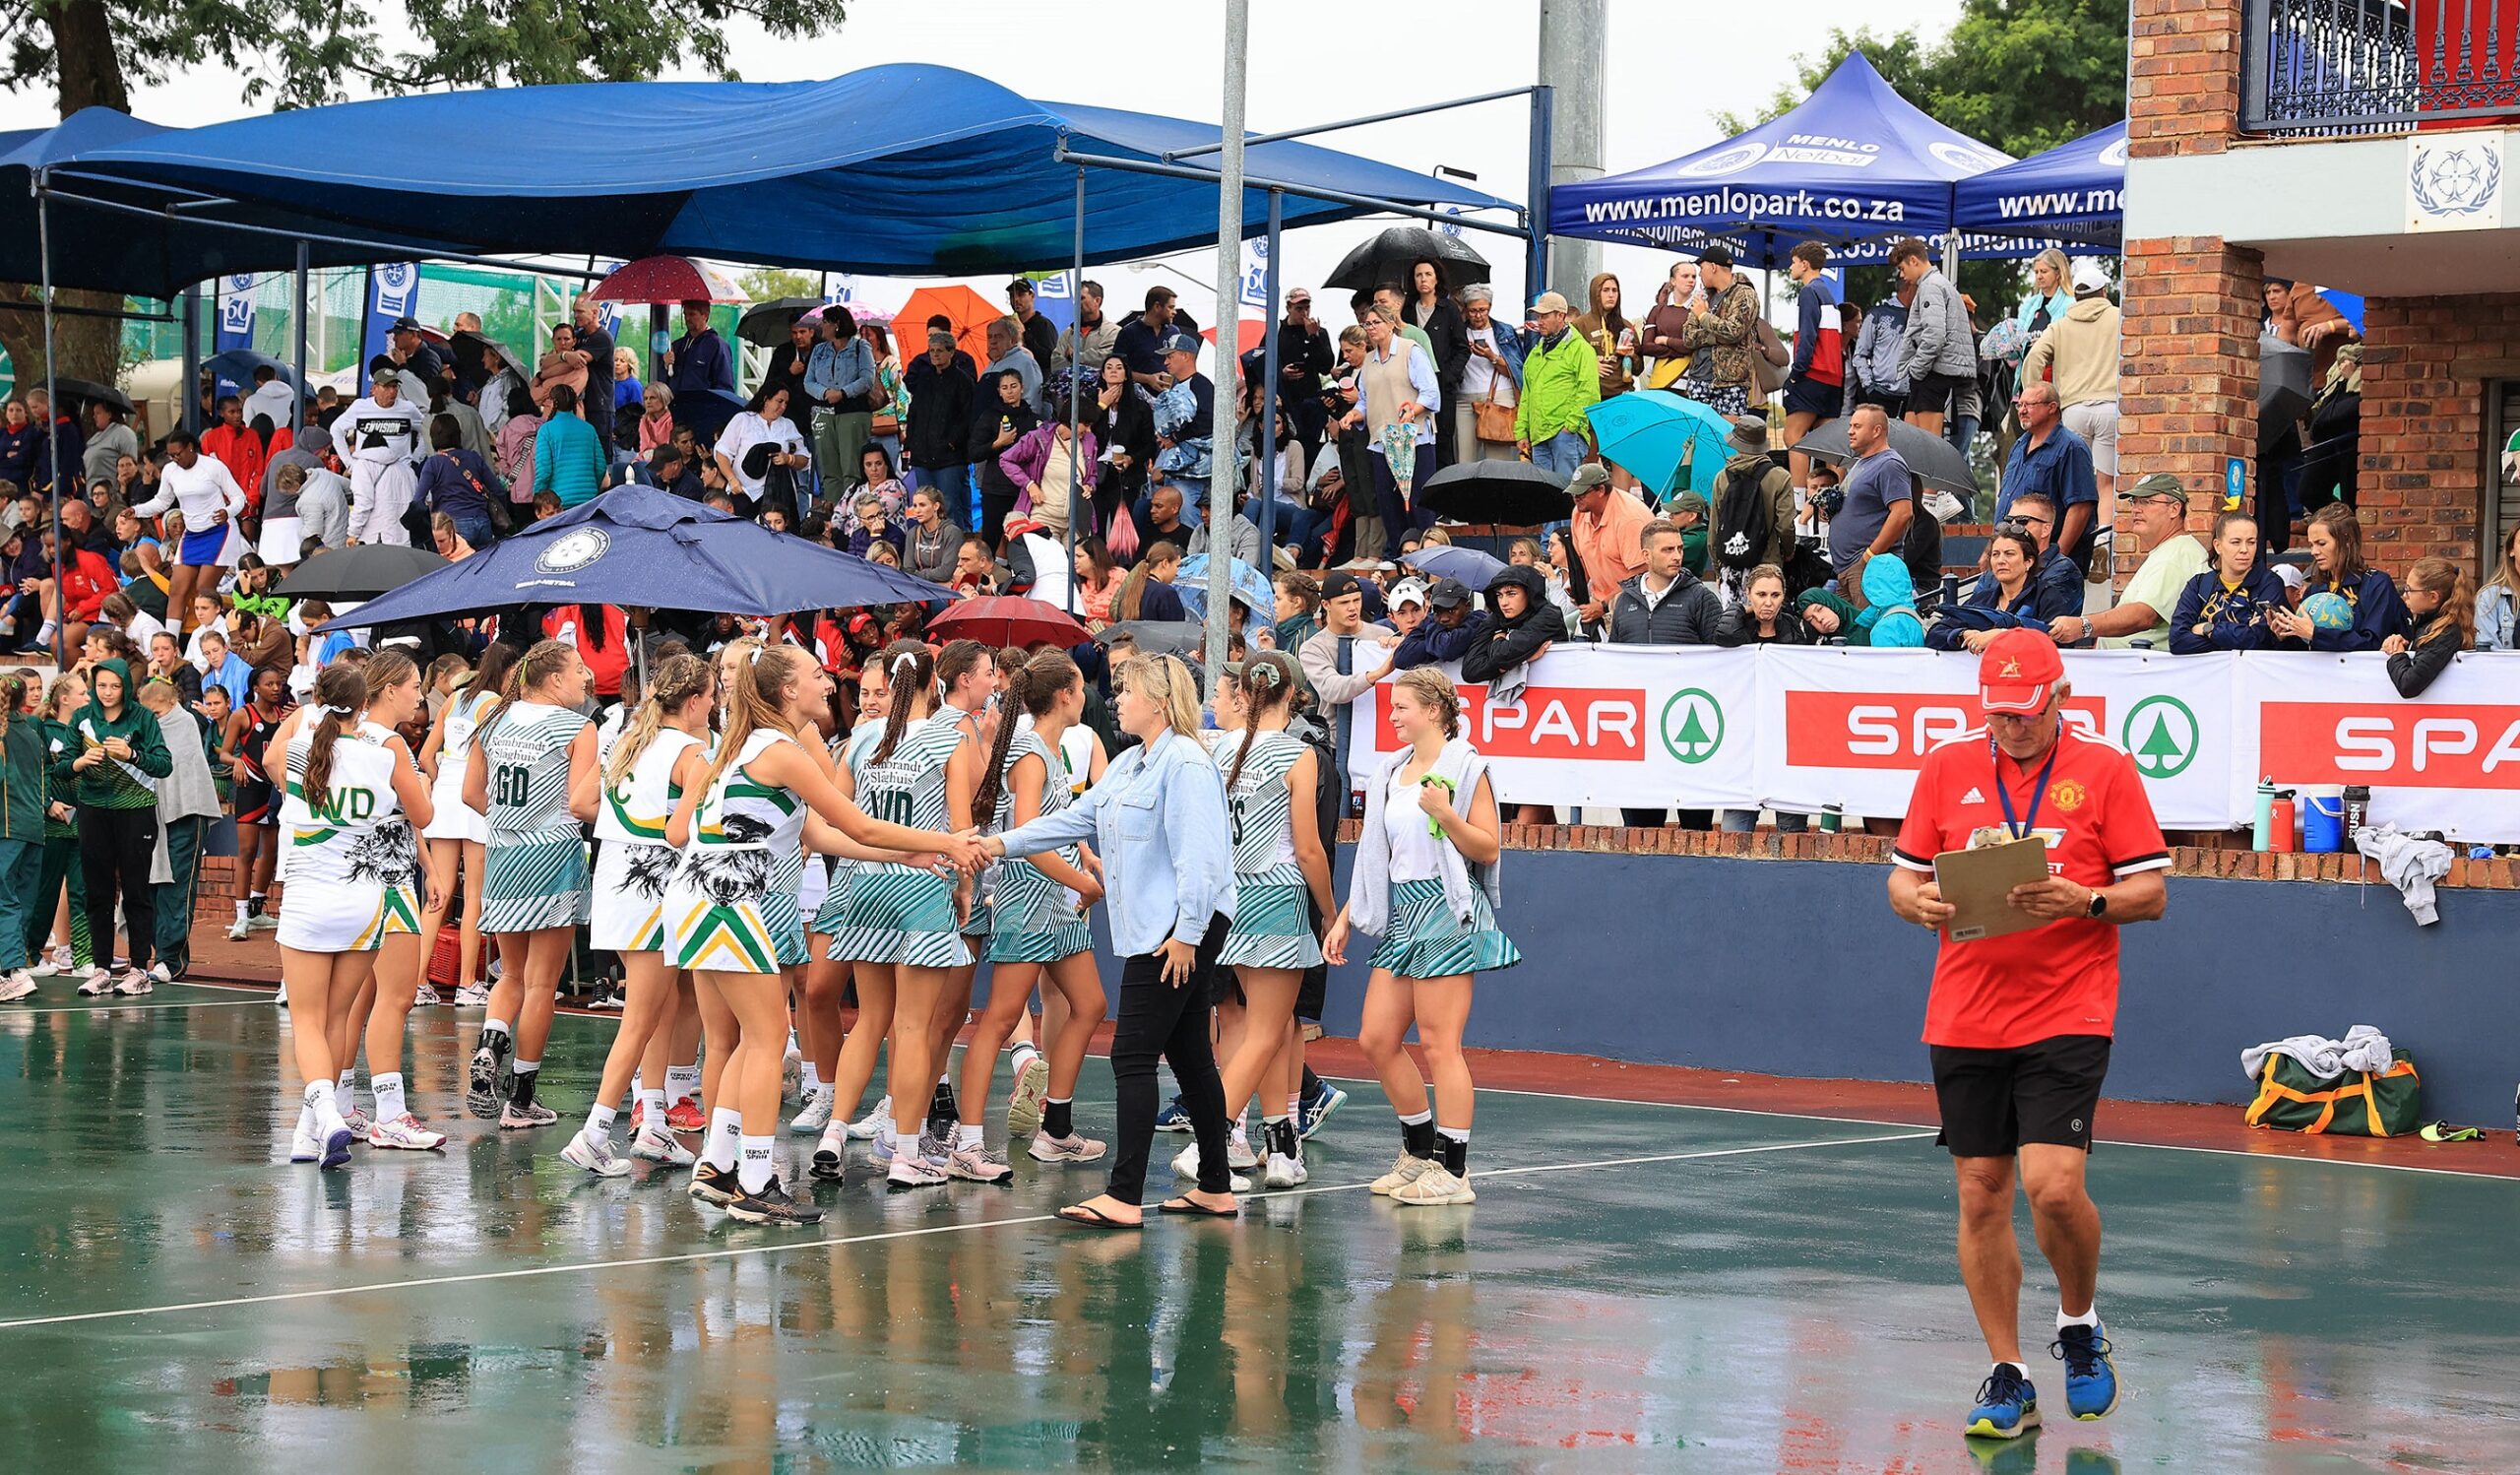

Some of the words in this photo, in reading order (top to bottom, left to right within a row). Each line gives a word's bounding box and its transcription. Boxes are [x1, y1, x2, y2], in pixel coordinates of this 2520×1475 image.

[1776, 149, 1865, 164] Netbal
[1786, 134, 1882, 154] MENLO
[1585, 187, 1905, 222] www.menlopark.co.za
[218, 297, 250, 322] 60
[1455, 695, 1637, 748] PAR
[1847, 705, 2096, 756] SP
[492, 737, 547, 752] Rembrandt
[493, 747, 537, 762] Slaghuis
[495, 764, 530, 807] GD
[870, 771, 914, 785] Slaghuis
[305, 786, 376, 820] WD
[2349, 802, 2361, 829] USN
